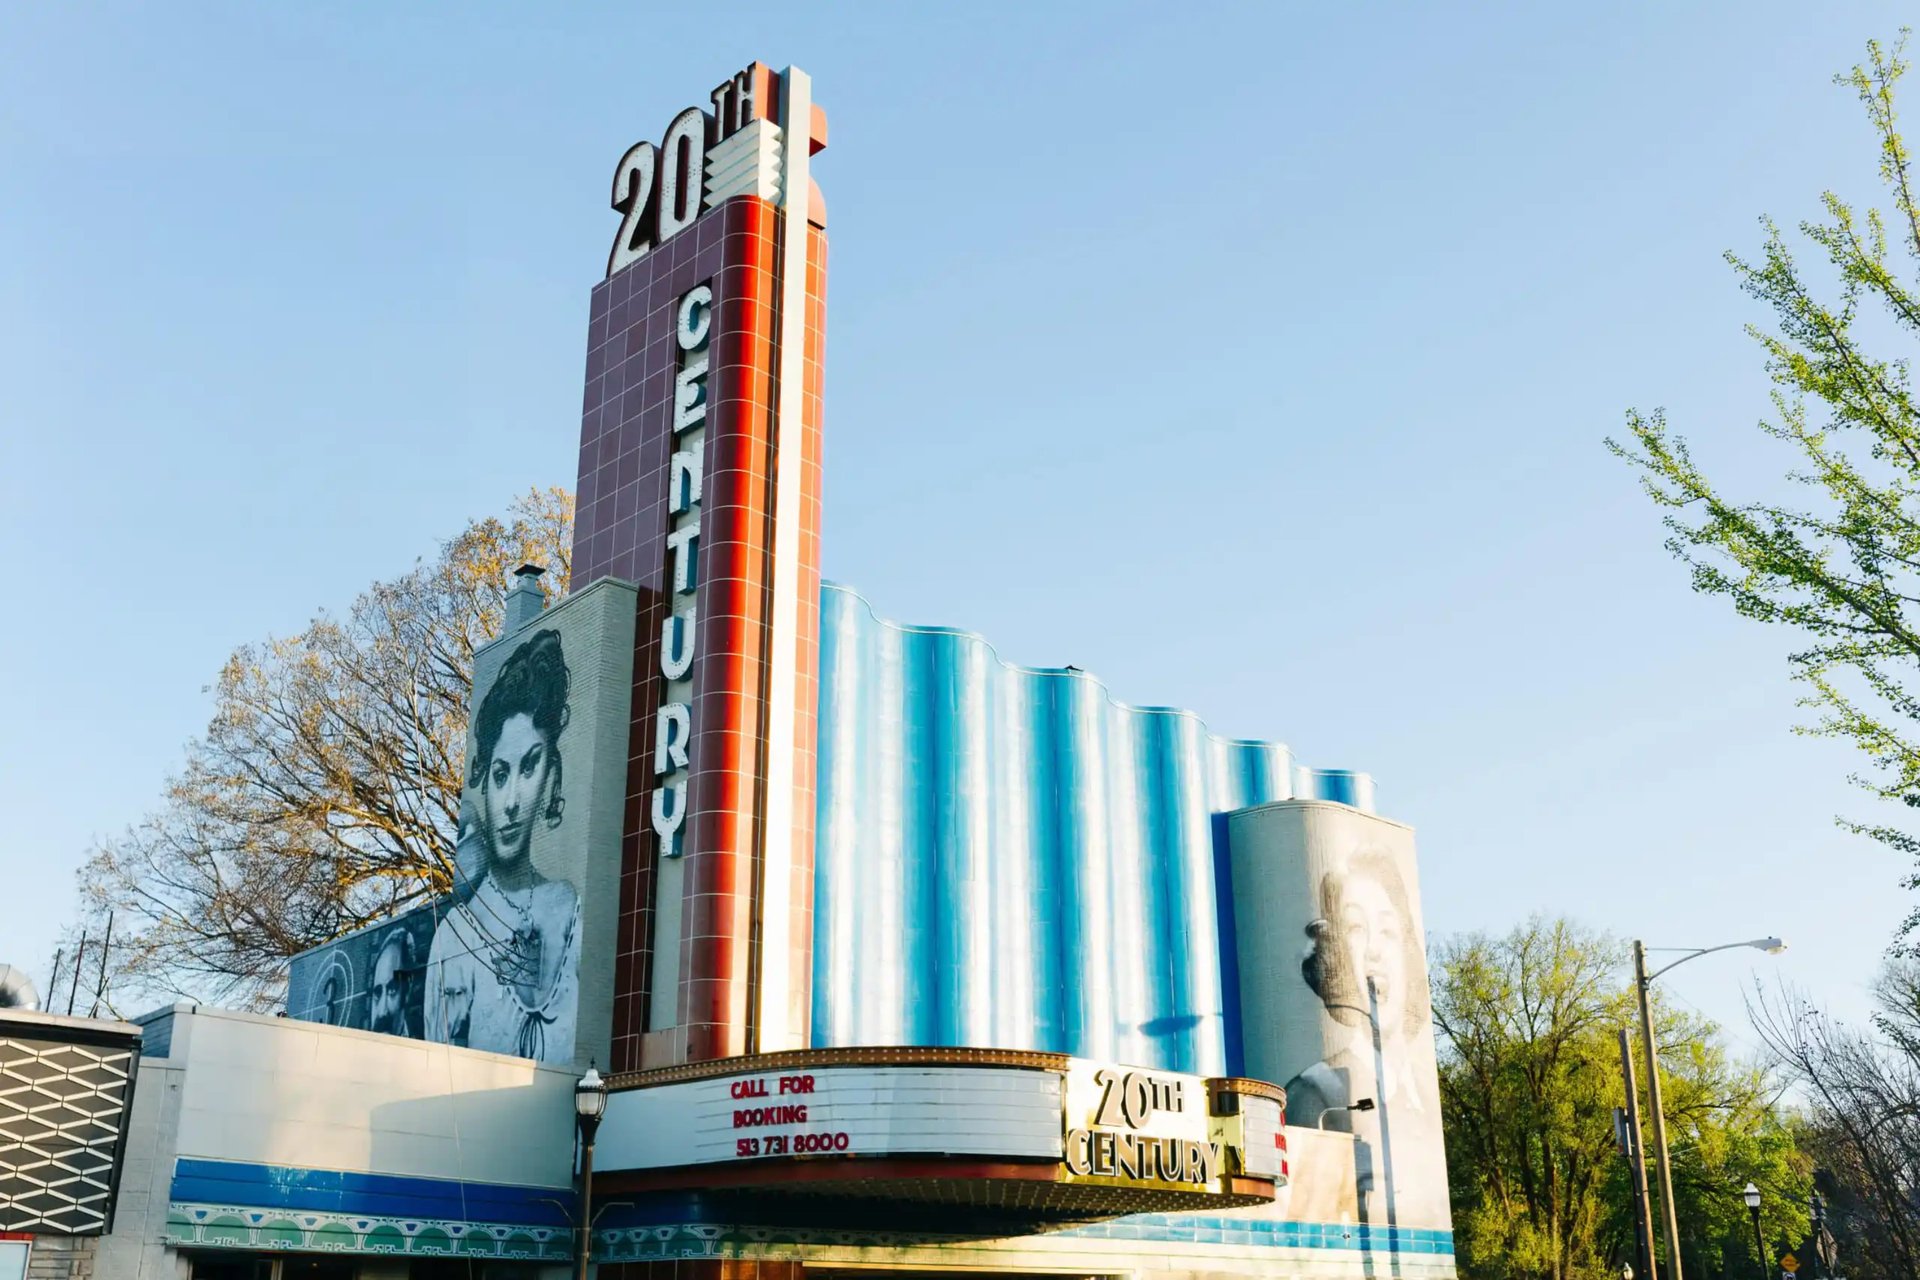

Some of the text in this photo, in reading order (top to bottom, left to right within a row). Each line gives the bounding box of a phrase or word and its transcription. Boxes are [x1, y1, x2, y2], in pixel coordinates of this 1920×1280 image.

[606, 61, 758, 277] 20TH
[730, 1075, 815, 1099] CALL FOR
[1094, 1069, 1185, 1130] 20TH
[733, 1105, 808, 1128] BOOKING
[736, 1131, 849, 1157] 513 731 8000
[1065, 1128, 1219, 1185] CENTURY
